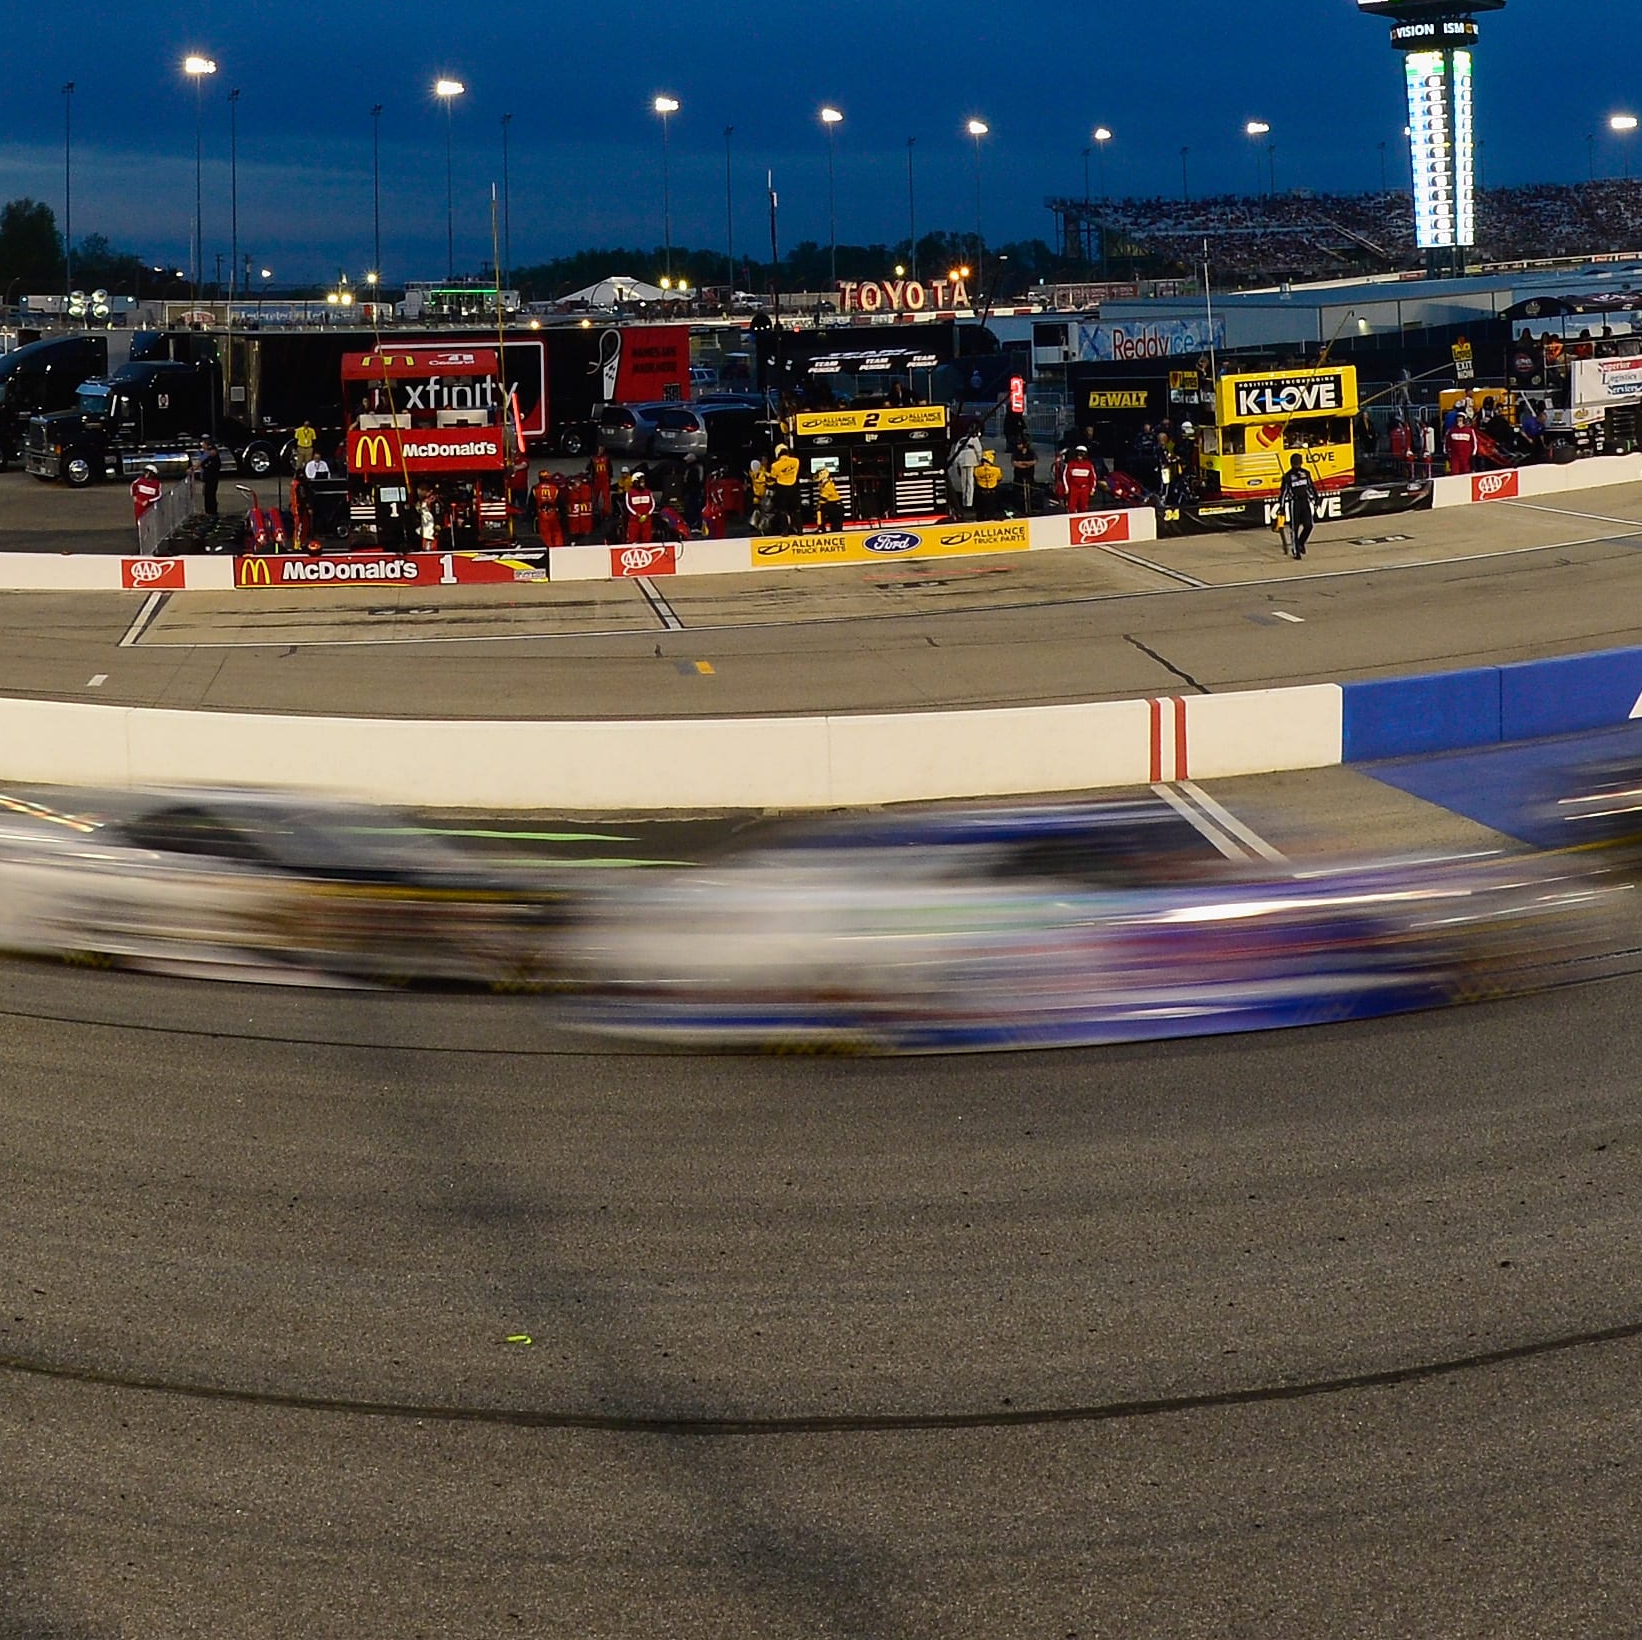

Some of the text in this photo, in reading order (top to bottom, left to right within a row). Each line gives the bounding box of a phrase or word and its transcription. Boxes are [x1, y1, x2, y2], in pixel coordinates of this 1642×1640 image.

[837, 279, 971, 311] TOYOTA
[405, 374, 518, 409] xfinity
[862, 412, 880, 428] 2
[402, 441, 498, 458] McDonald's
[1481, 477, 1501, 491] AAA
[973, 526, 1026, 538] ALLIANCE
[1079, 520, 1106, 535] AAA
[791, 536, 846, 550] ALLIANCE
[871, 534, 914, 551] Ford
[973, 534, 1026, 546] TRUCK PARTS
[624, 550, 650, 566] AAA
[791, 544, 846, 556] TRUCK PARTS
[135, 561, 159, 576] AAA
[283, 559, 418, 581] McDonald's
[439, 554, 457, 584] 1
